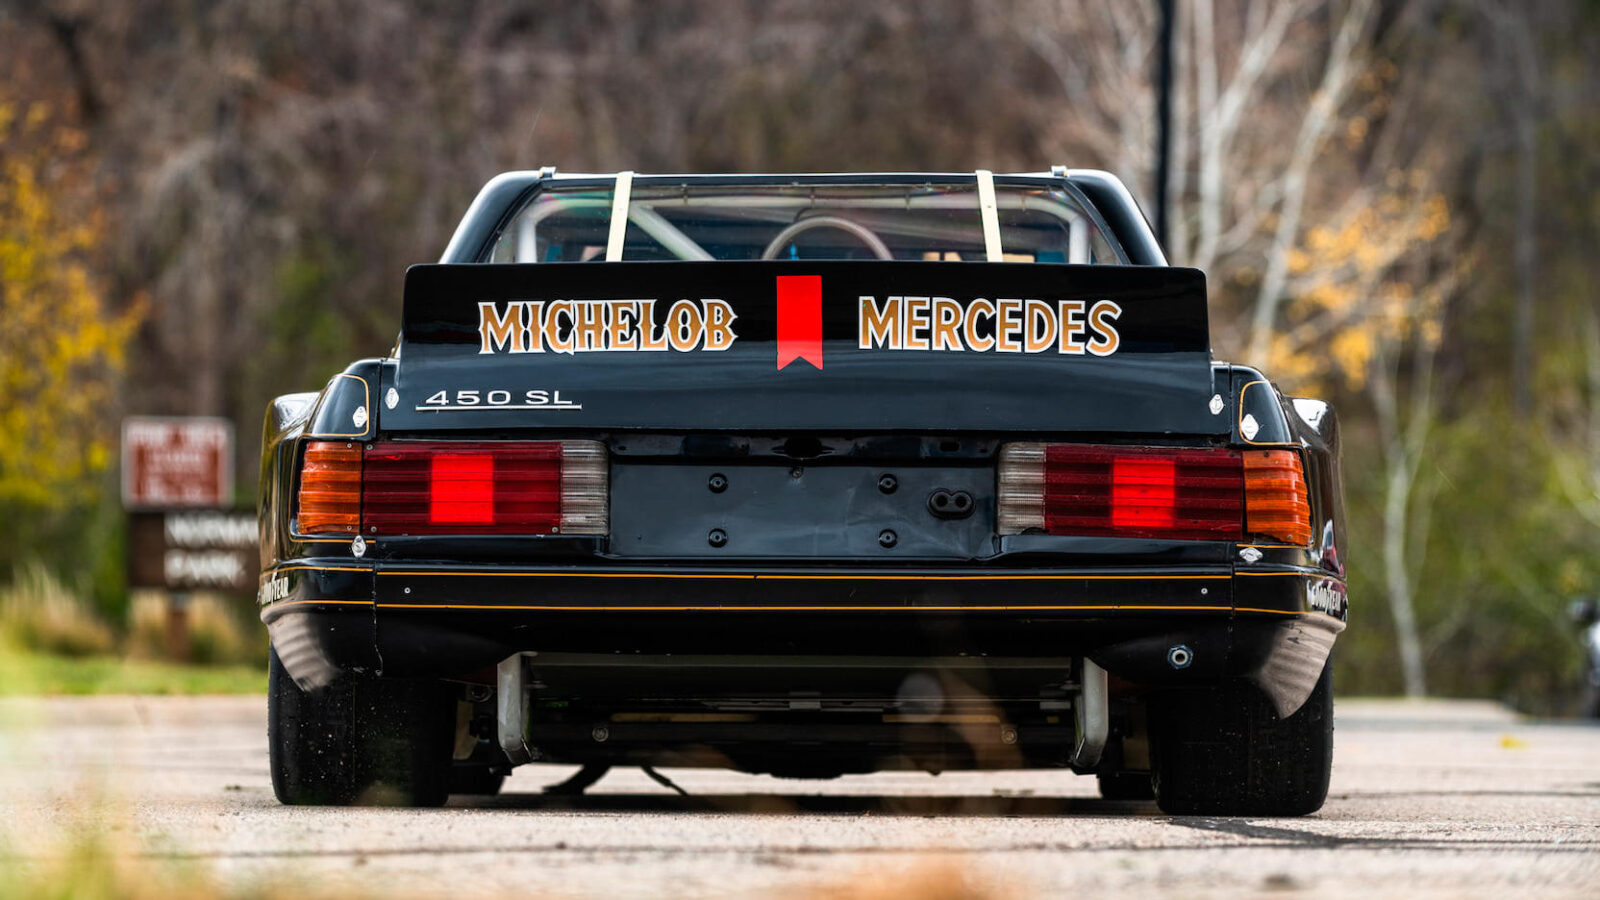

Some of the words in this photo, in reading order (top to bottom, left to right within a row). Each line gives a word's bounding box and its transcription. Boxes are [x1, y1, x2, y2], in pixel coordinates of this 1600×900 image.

[478, 299, 738, 355] MICHELOB
[858, 296, 1122, 357] MERCEDES
[425, 390, 511, 406] 450
[525, 390, 573, 405] SL
